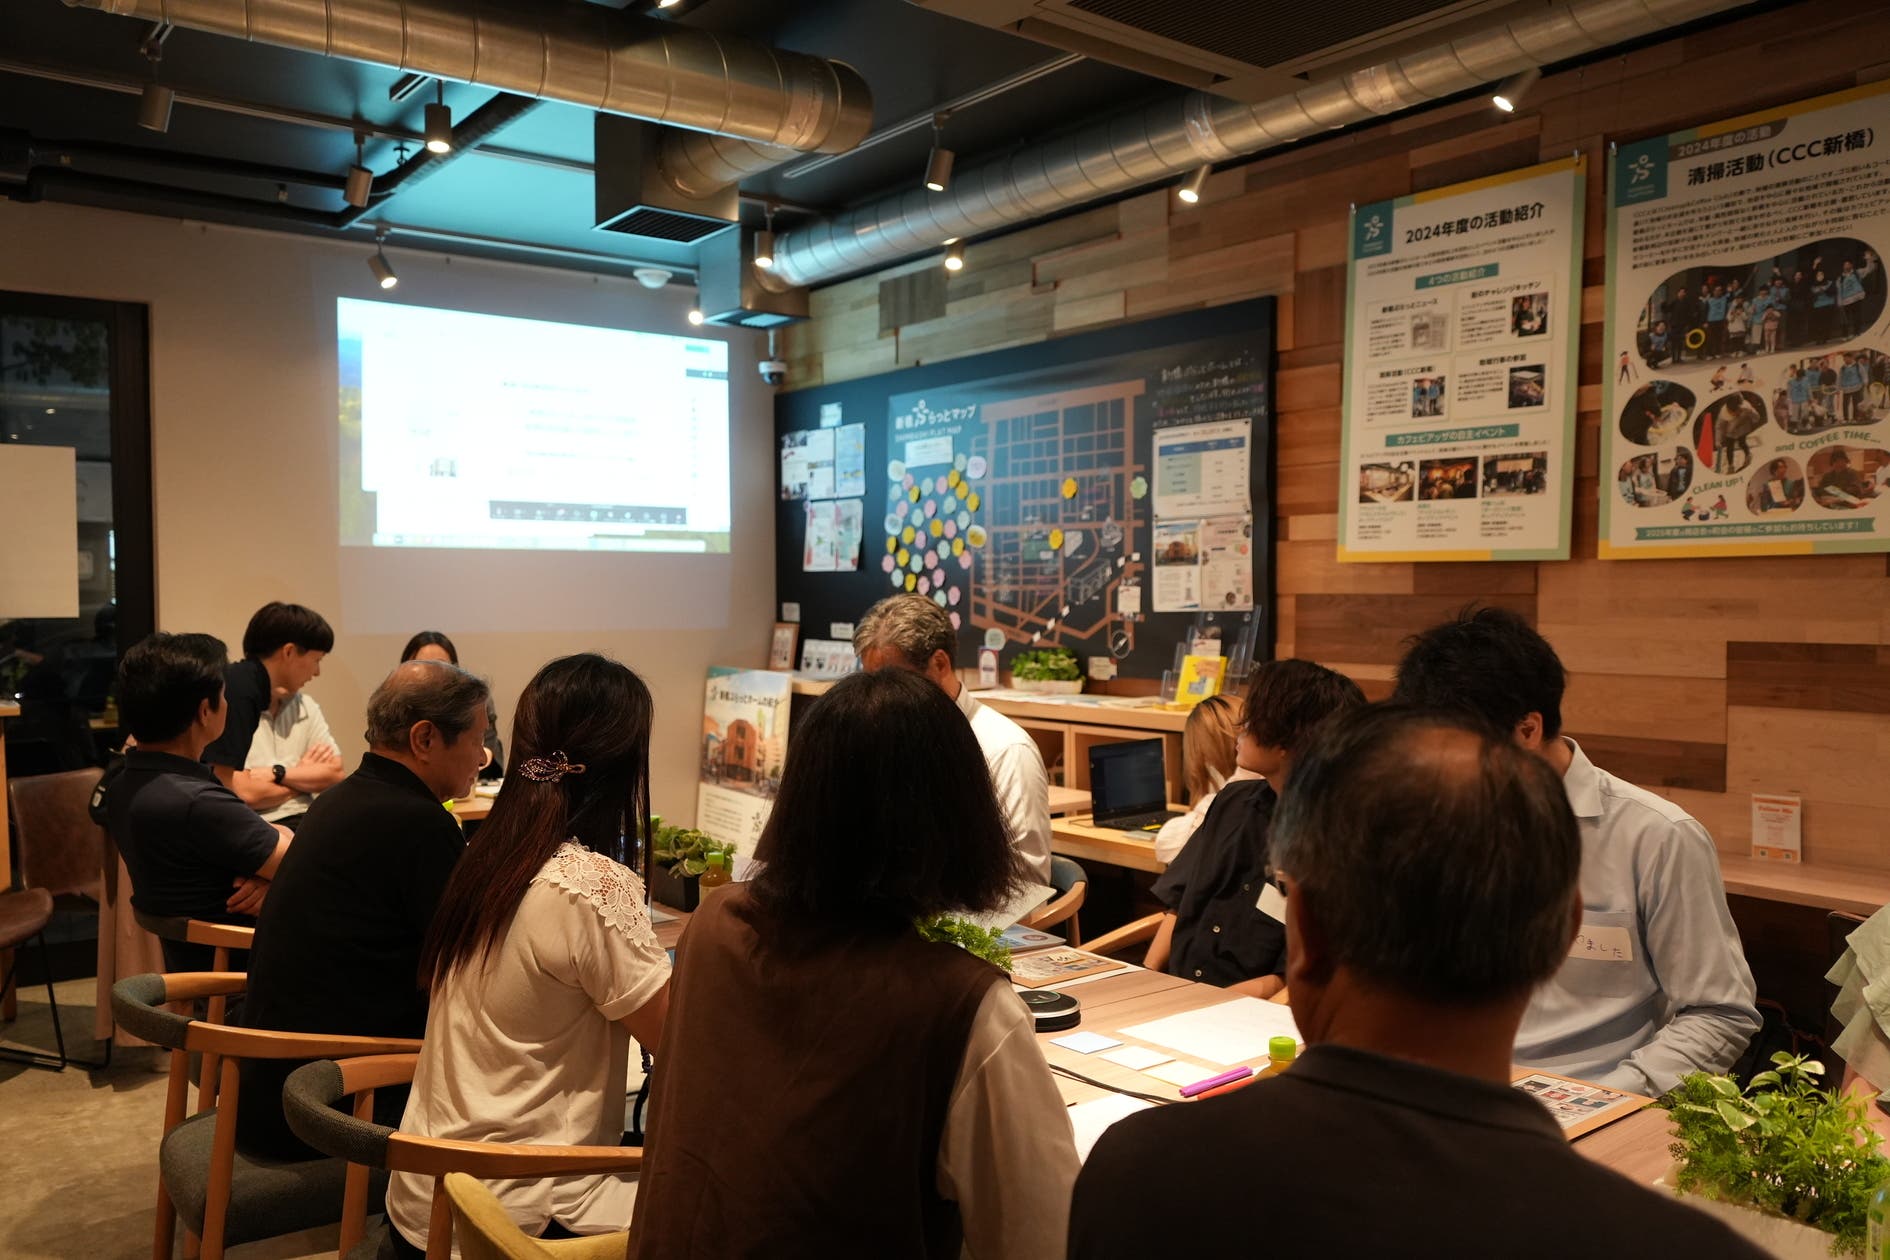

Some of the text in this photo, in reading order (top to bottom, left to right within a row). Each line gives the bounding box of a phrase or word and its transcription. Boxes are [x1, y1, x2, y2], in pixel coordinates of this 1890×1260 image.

[1405, 202, 1545, 244] 2024年度の活動紹介
[1775, 441, 1795, 452] and
[1799, 430, 1840, 450] COFFEE
[1692, 476, 1744, 495] CLEAN UP!
